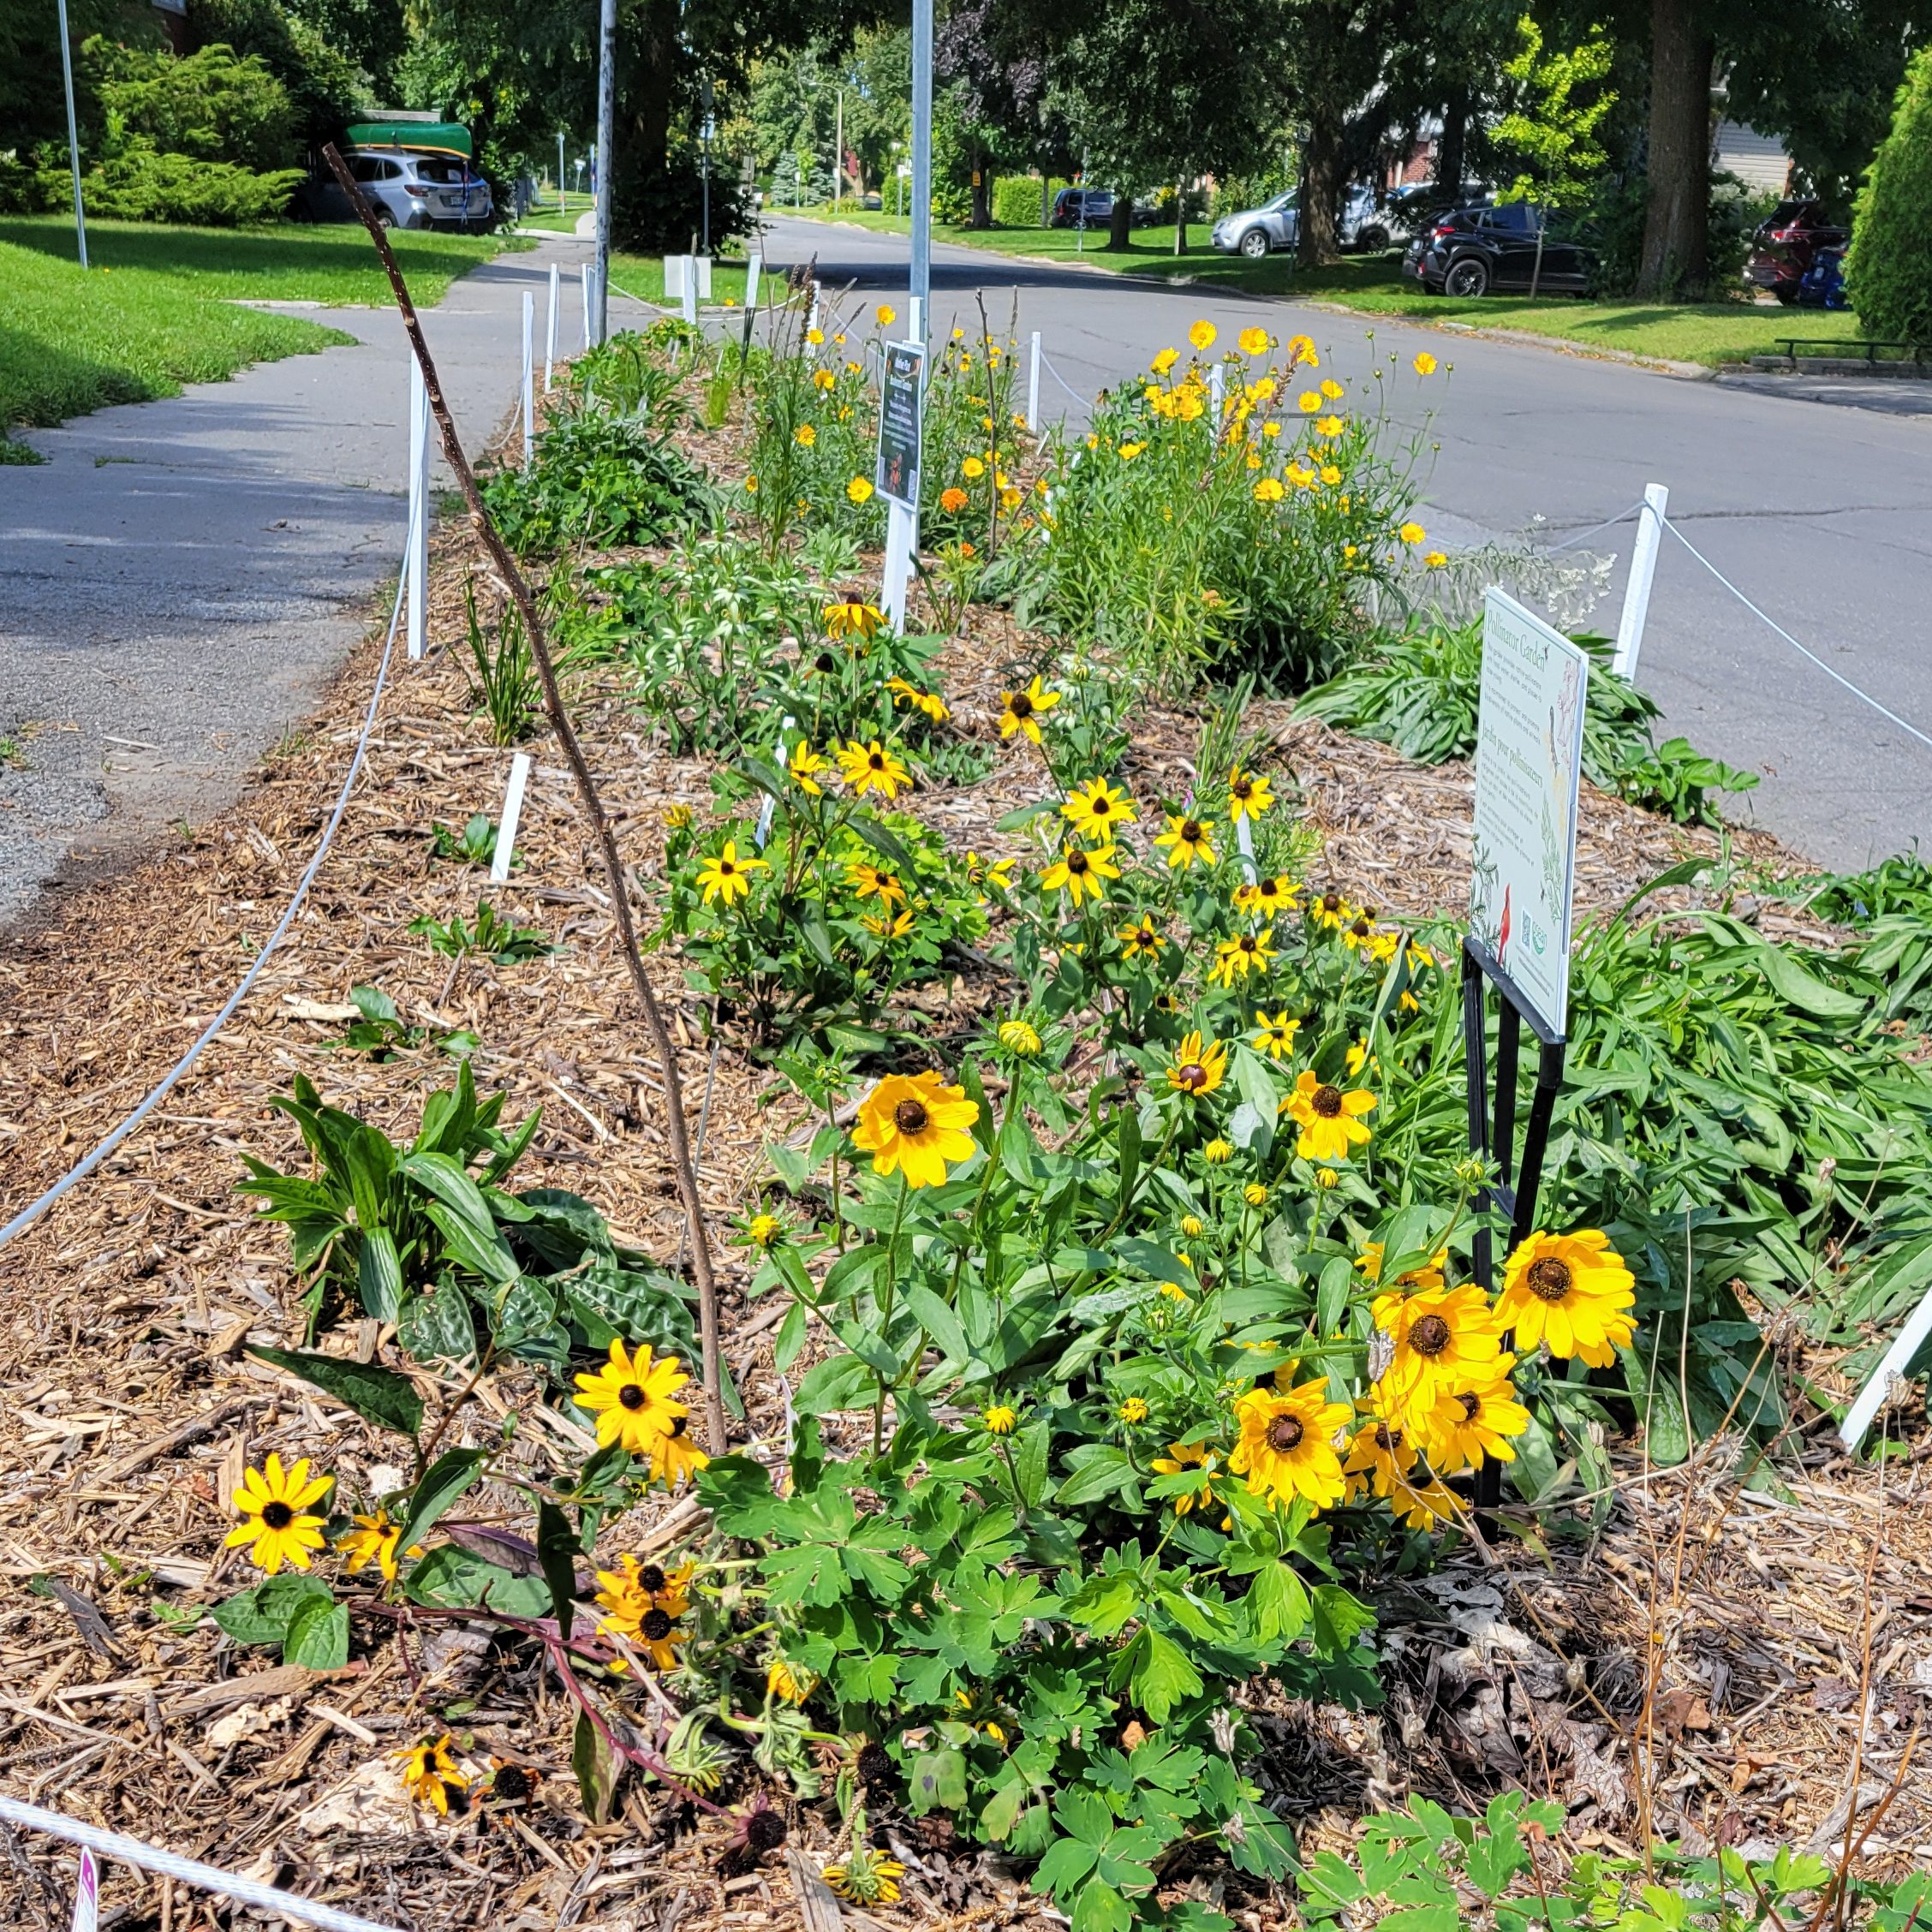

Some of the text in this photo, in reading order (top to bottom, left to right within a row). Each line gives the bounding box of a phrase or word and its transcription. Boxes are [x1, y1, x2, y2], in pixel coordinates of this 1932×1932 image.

[1488, 610, 1545, 672] Pollinator Garden
[1482, 720, 1497, 747] Jardin
[1498, 739, 1509, 756] pour
[1510, 748, 1543, 788] pollinisateurs
